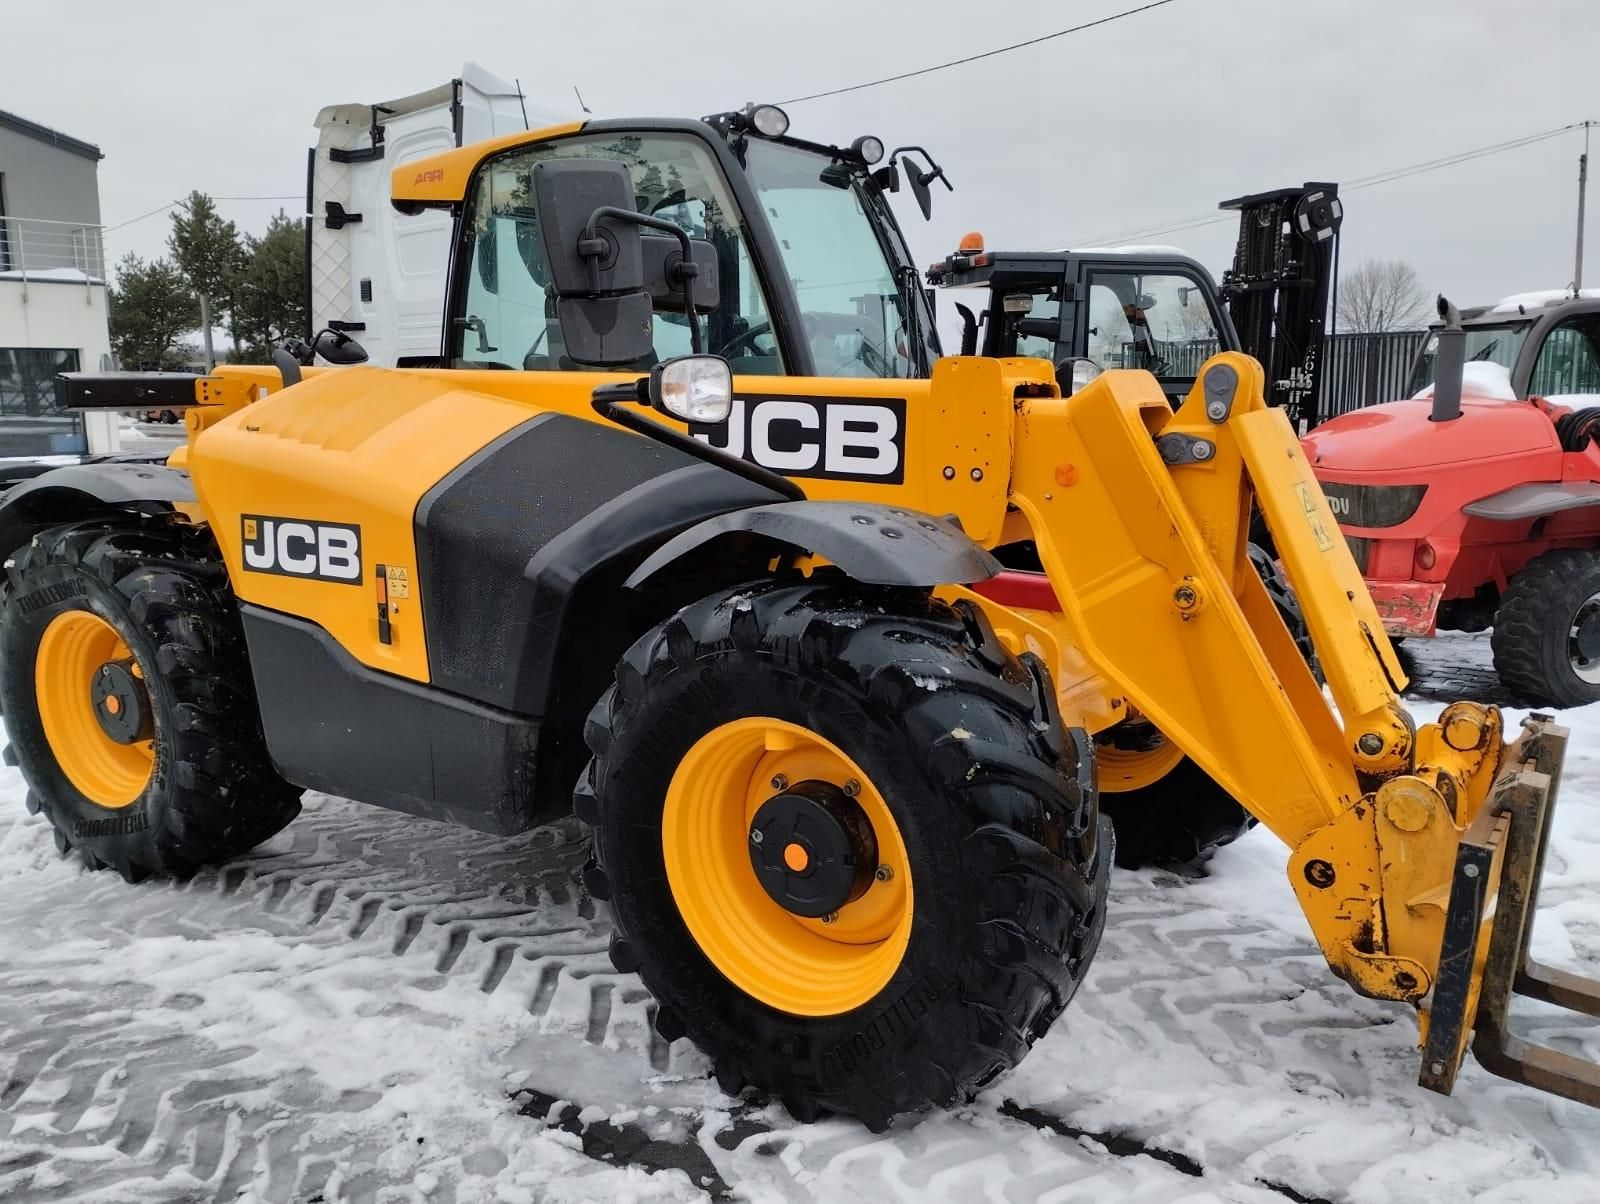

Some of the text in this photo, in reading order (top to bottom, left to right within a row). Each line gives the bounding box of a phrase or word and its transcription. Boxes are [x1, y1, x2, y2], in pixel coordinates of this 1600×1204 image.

[414, 168, 444, 186] AGRI
[693, 399, 899, 476] JCB
[244, 521, 360, 579] JCB
